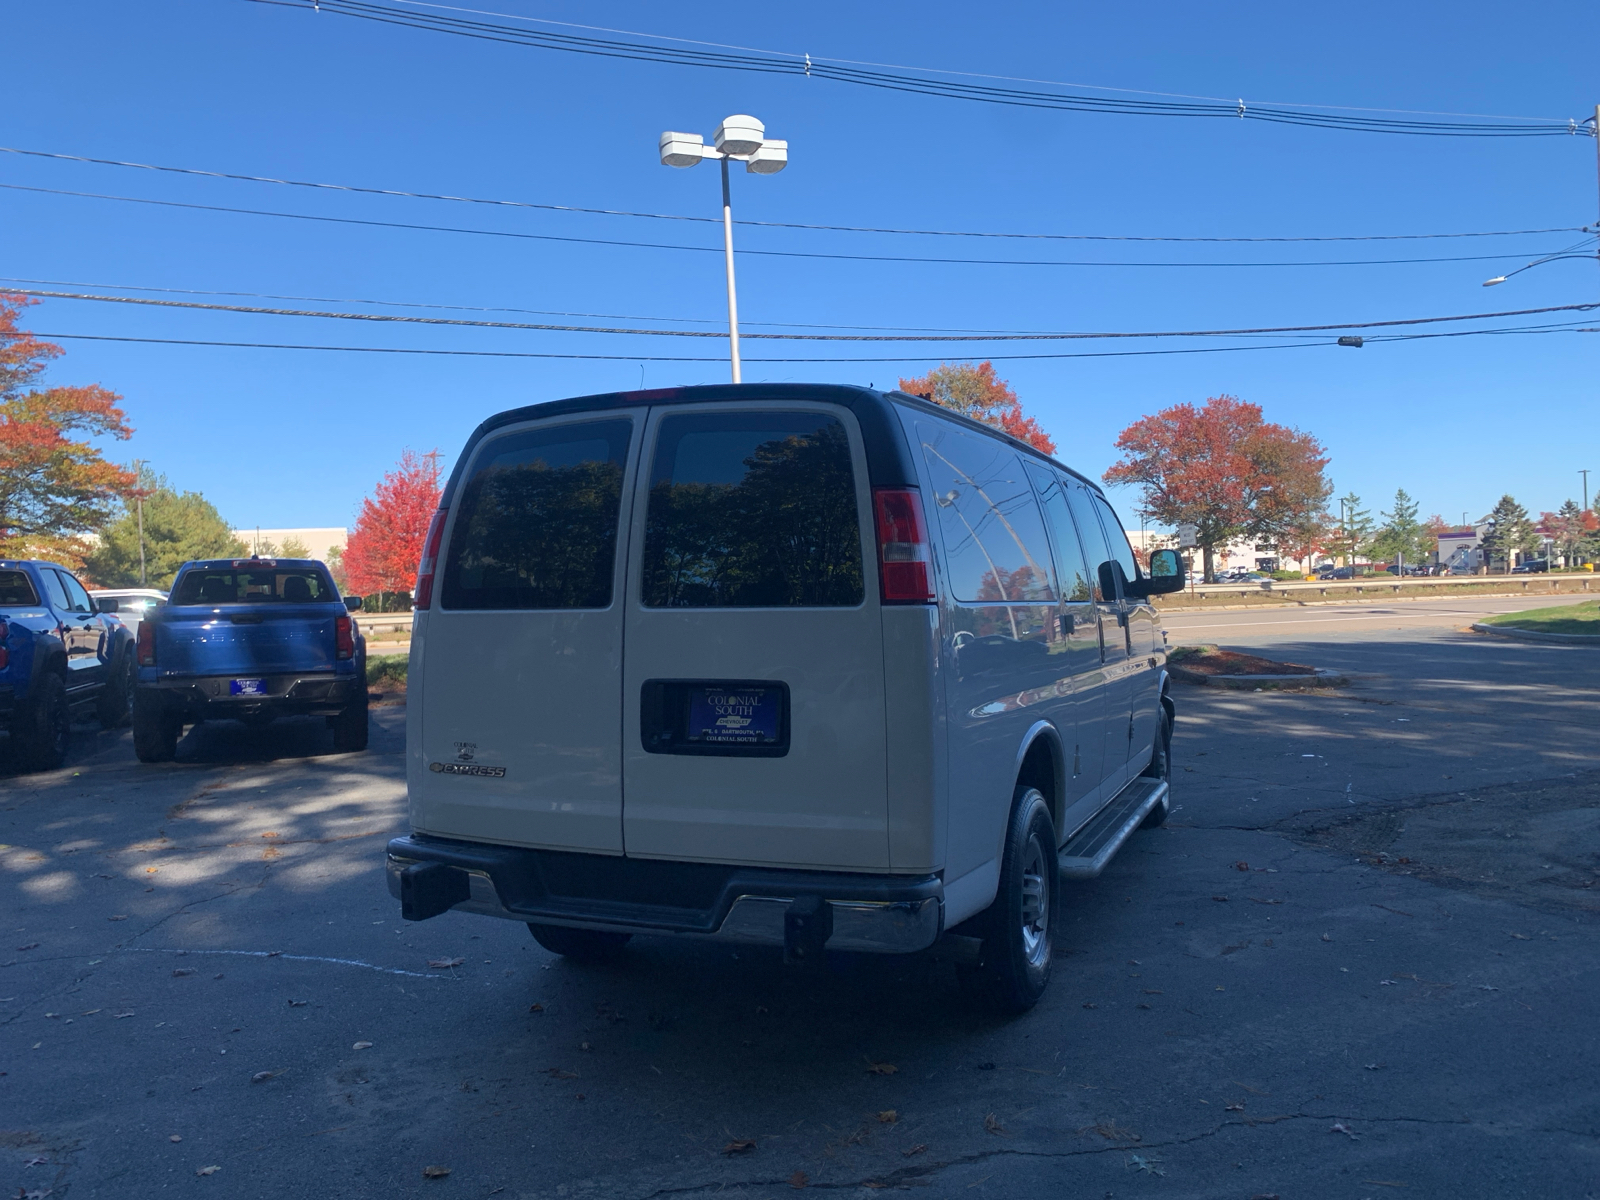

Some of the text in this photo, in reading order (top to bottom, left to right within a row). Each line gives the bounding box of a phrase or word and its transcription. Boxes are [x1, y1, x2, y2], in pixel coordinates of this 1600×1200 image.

[708, 696, 762, 706] COLONIAL
[716, 706, 752, 715] SOUTH
[444, 764, 506, 778] EXPRESS
